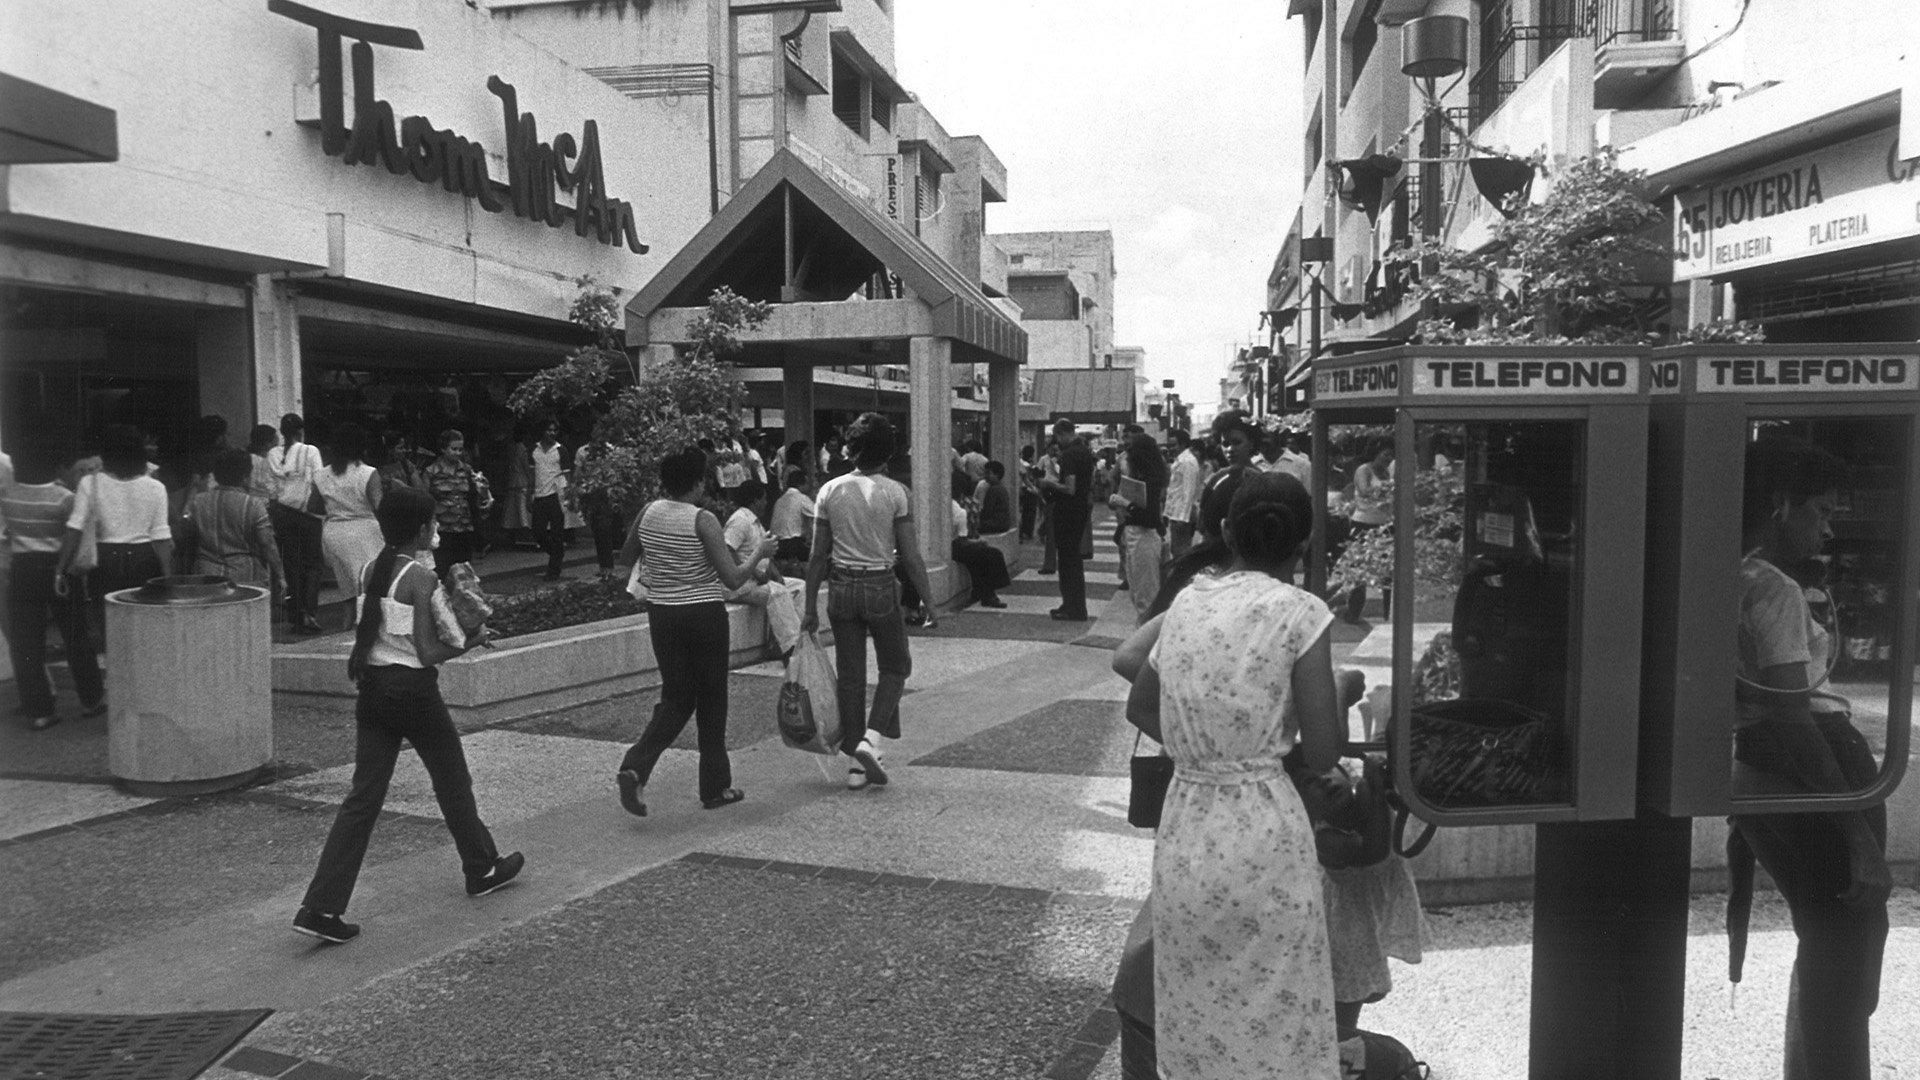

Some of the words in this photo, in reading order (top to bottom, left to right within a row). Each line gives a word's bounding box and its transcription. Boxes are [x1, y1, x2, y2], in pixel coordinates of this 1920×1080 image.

[268, 0, 503, 213] Thom
[1715, 162, 1824, 229] JOYERIA
[1677, 203, 1707, 262] 65
[1809, 213, 1869, 246] PLATERIA
[1715, 236, 1772, 265] RELOJERIA
[1333, 363, 1398, 393] TELEFONO
[1427, 361, 1627, 388] TELEFONO
[1710, 359, 1906, 386] TELEFONO
